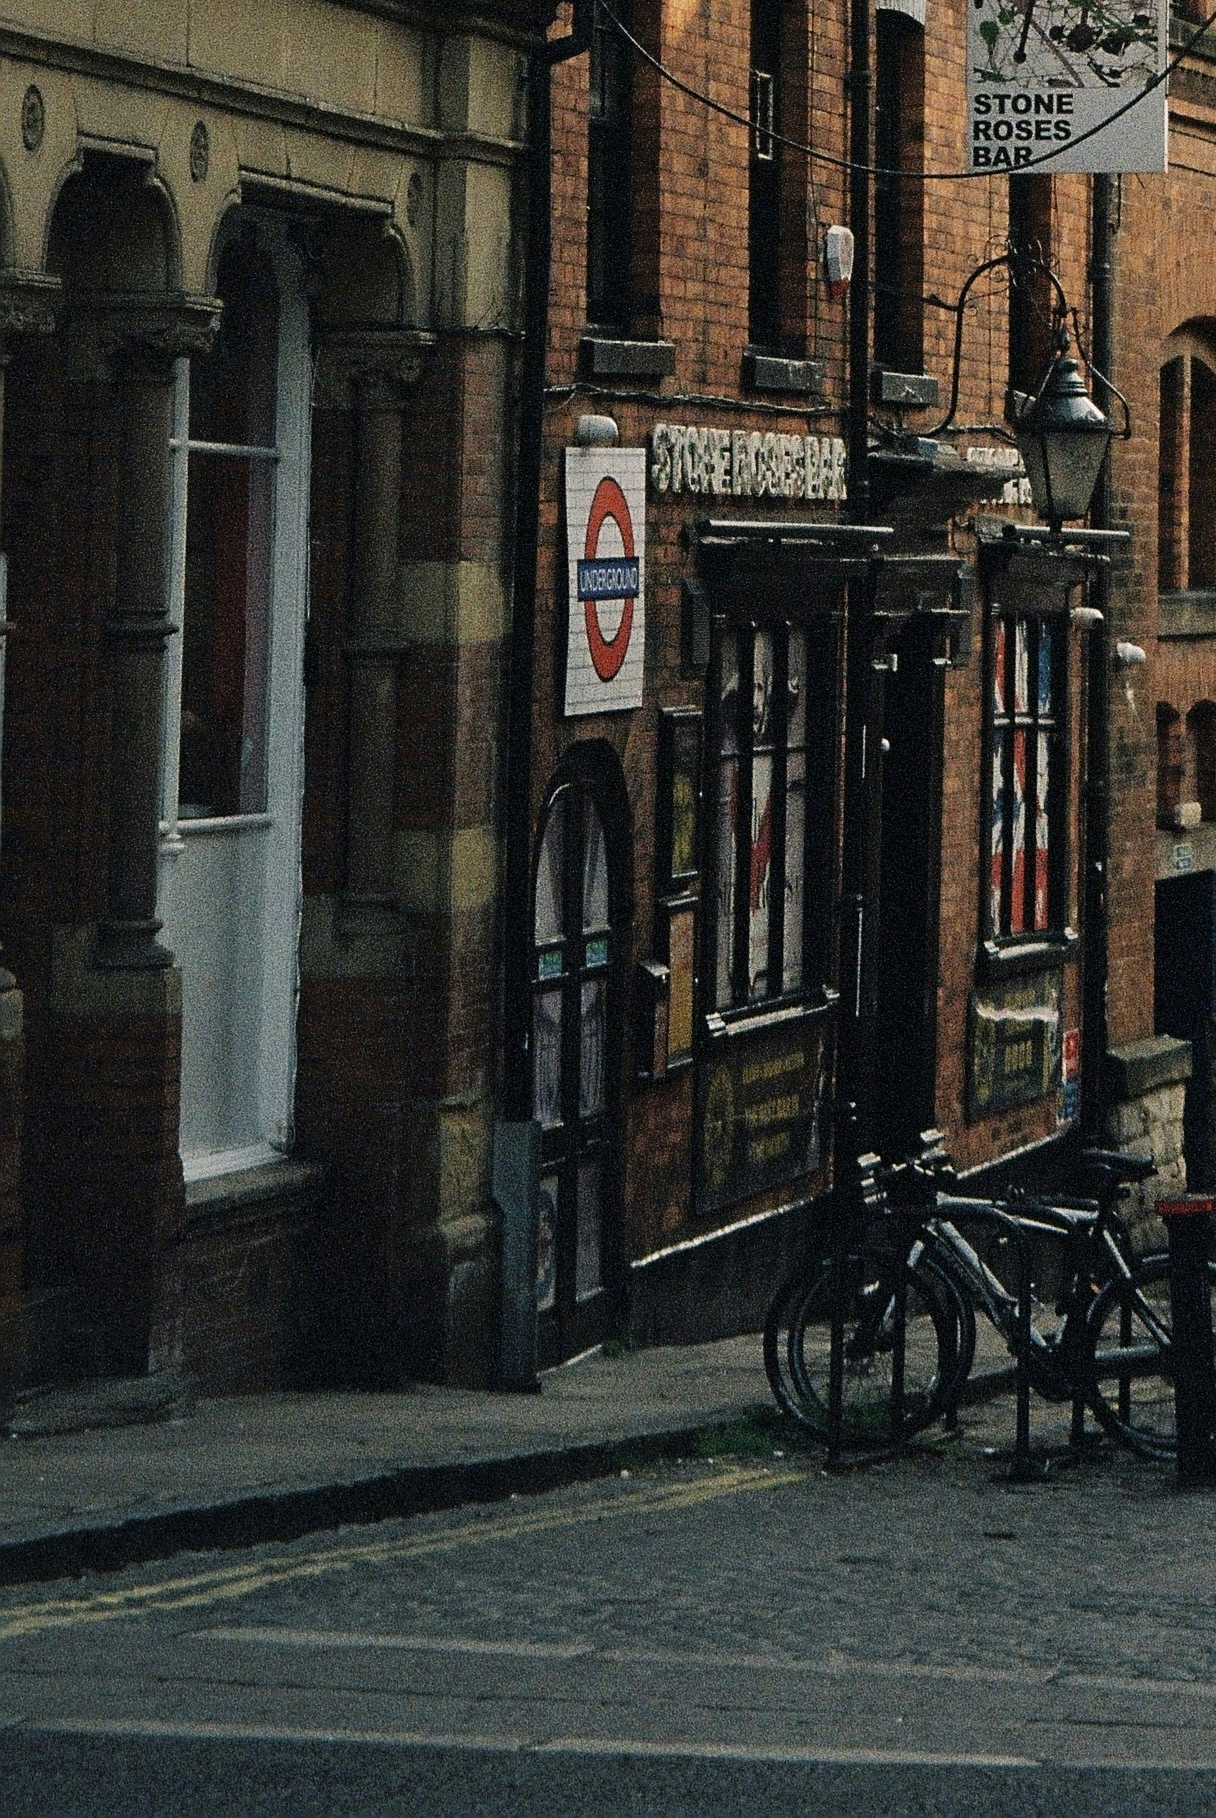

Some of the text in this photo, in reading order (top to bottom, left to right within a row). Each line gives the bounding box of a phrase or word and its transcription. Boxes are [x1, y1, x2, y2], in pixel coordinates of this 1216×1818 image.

[973, 93, 1074, 116] STONE
[973, 119, 1072, 142] ROSES
[972, 146, 1034, 168] BAR
[651, 422, 731, 495] STONE
[804, 436, 848, 500] BAR
[580, 567, 638, 593] UNDERGROUND
